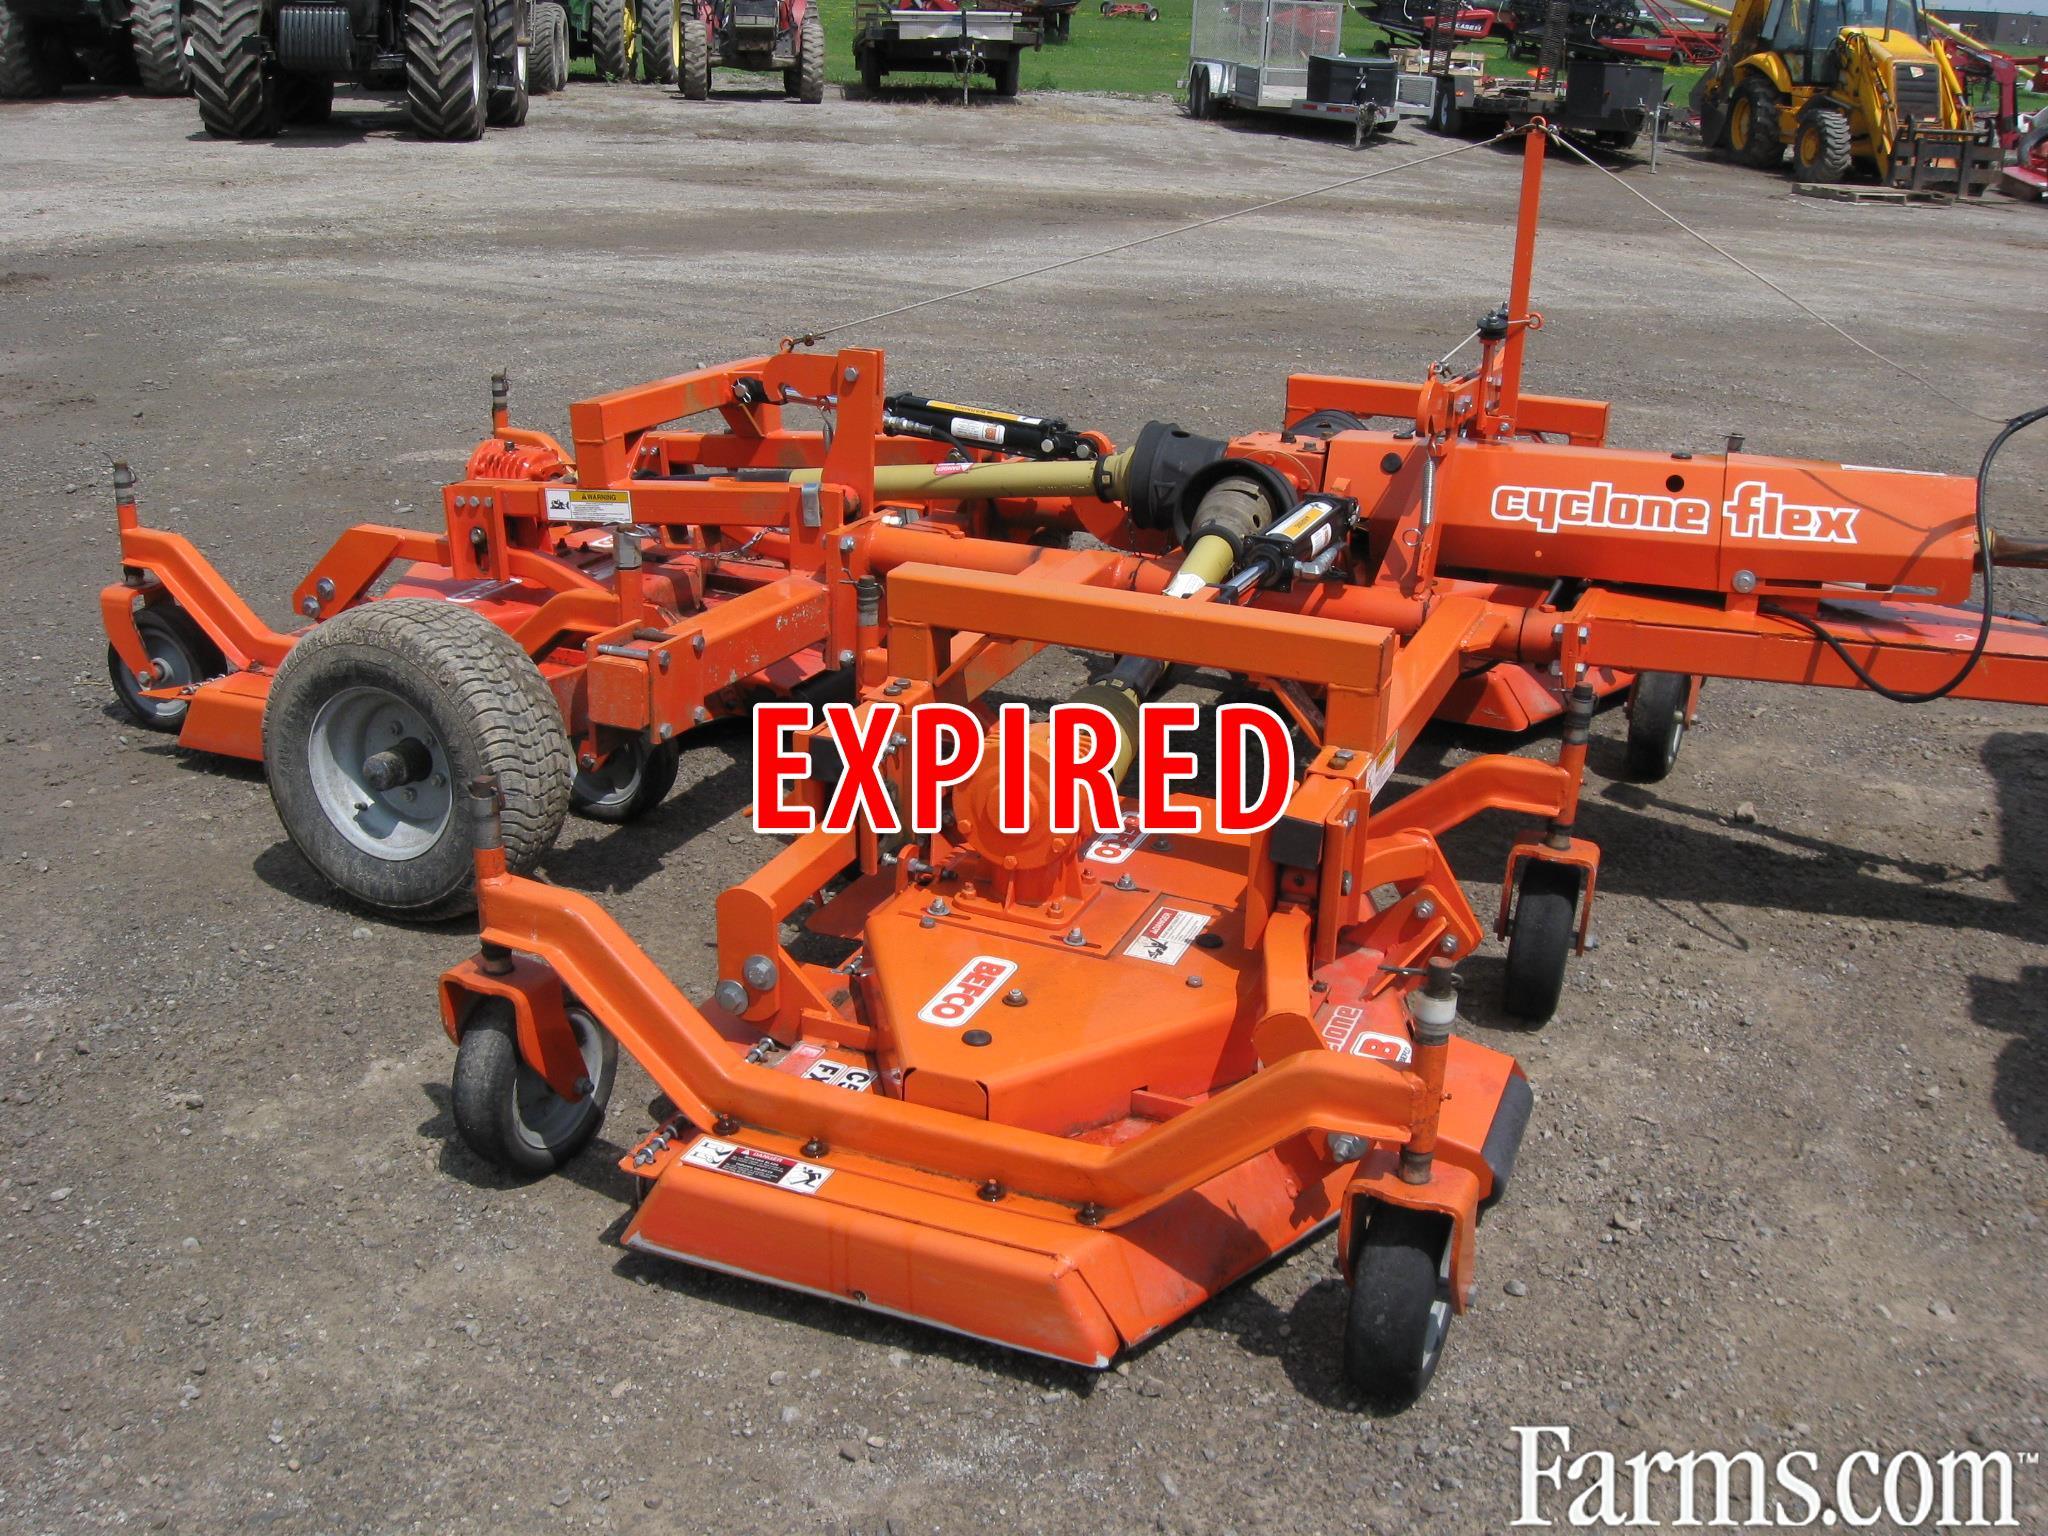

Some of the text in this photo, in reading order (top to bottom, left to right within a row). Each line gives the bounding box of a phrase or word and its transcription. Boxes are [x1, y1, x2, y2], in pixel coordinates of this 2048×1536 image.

[1491, 481, 1860, 544] cyclone flex
[932, 961, 1007, 1019] BEFCO
[753, 1151, 784, 1163] DANGER
